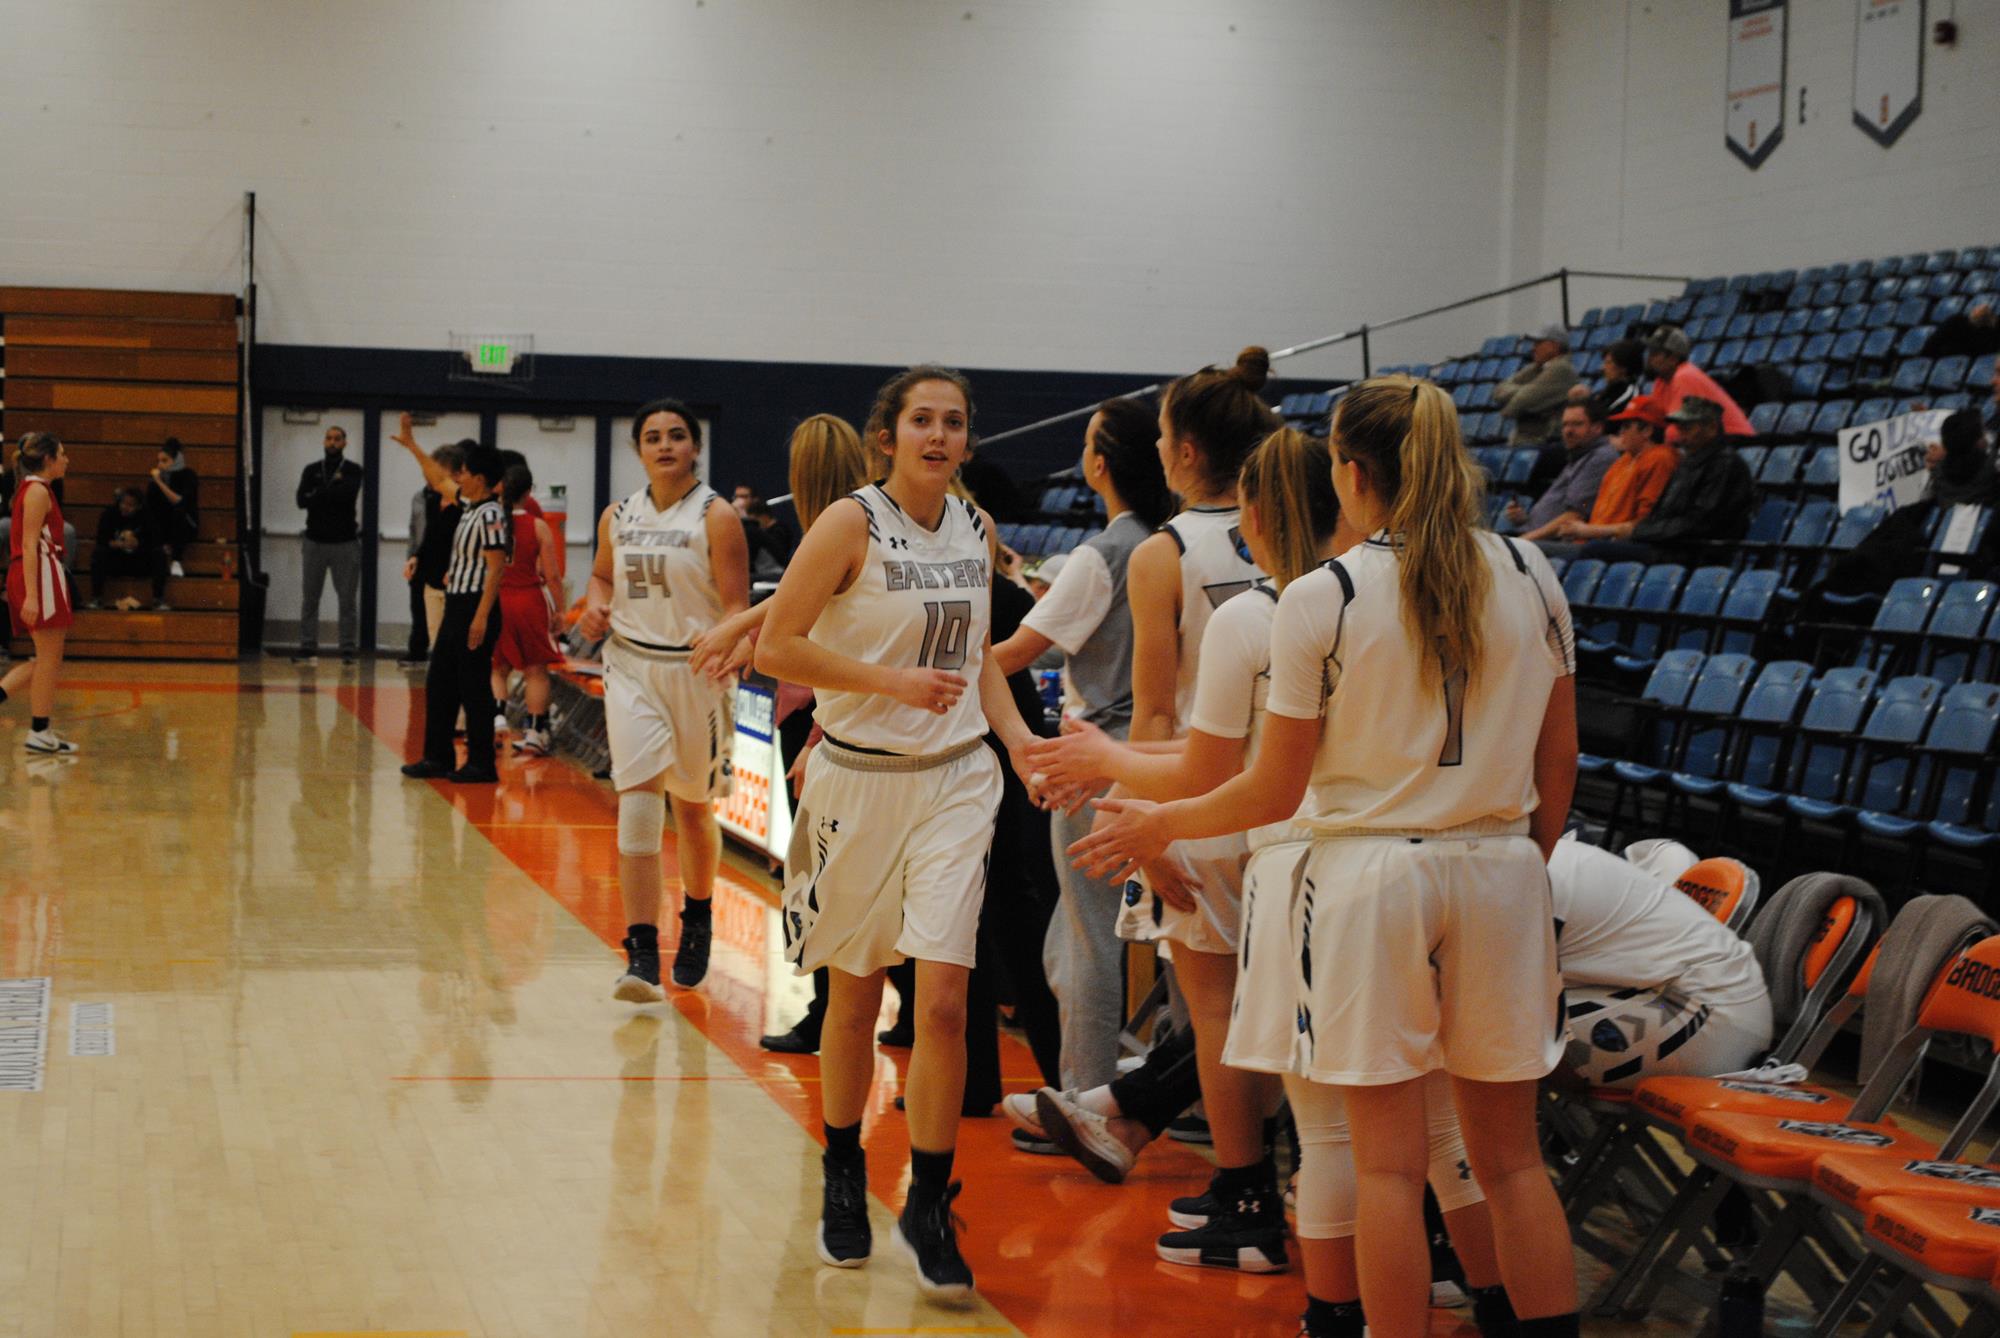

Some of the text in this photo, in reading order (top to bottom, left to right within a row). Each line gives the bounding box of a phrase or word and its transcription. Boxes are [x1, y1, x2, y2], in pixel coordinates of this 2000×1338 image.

[1849, 428, 1882, 463] GO
[624, 554, 671, 599] 24
[883, 558, 989, 592] EASTERN
[917, 600, 971, 670] 10
